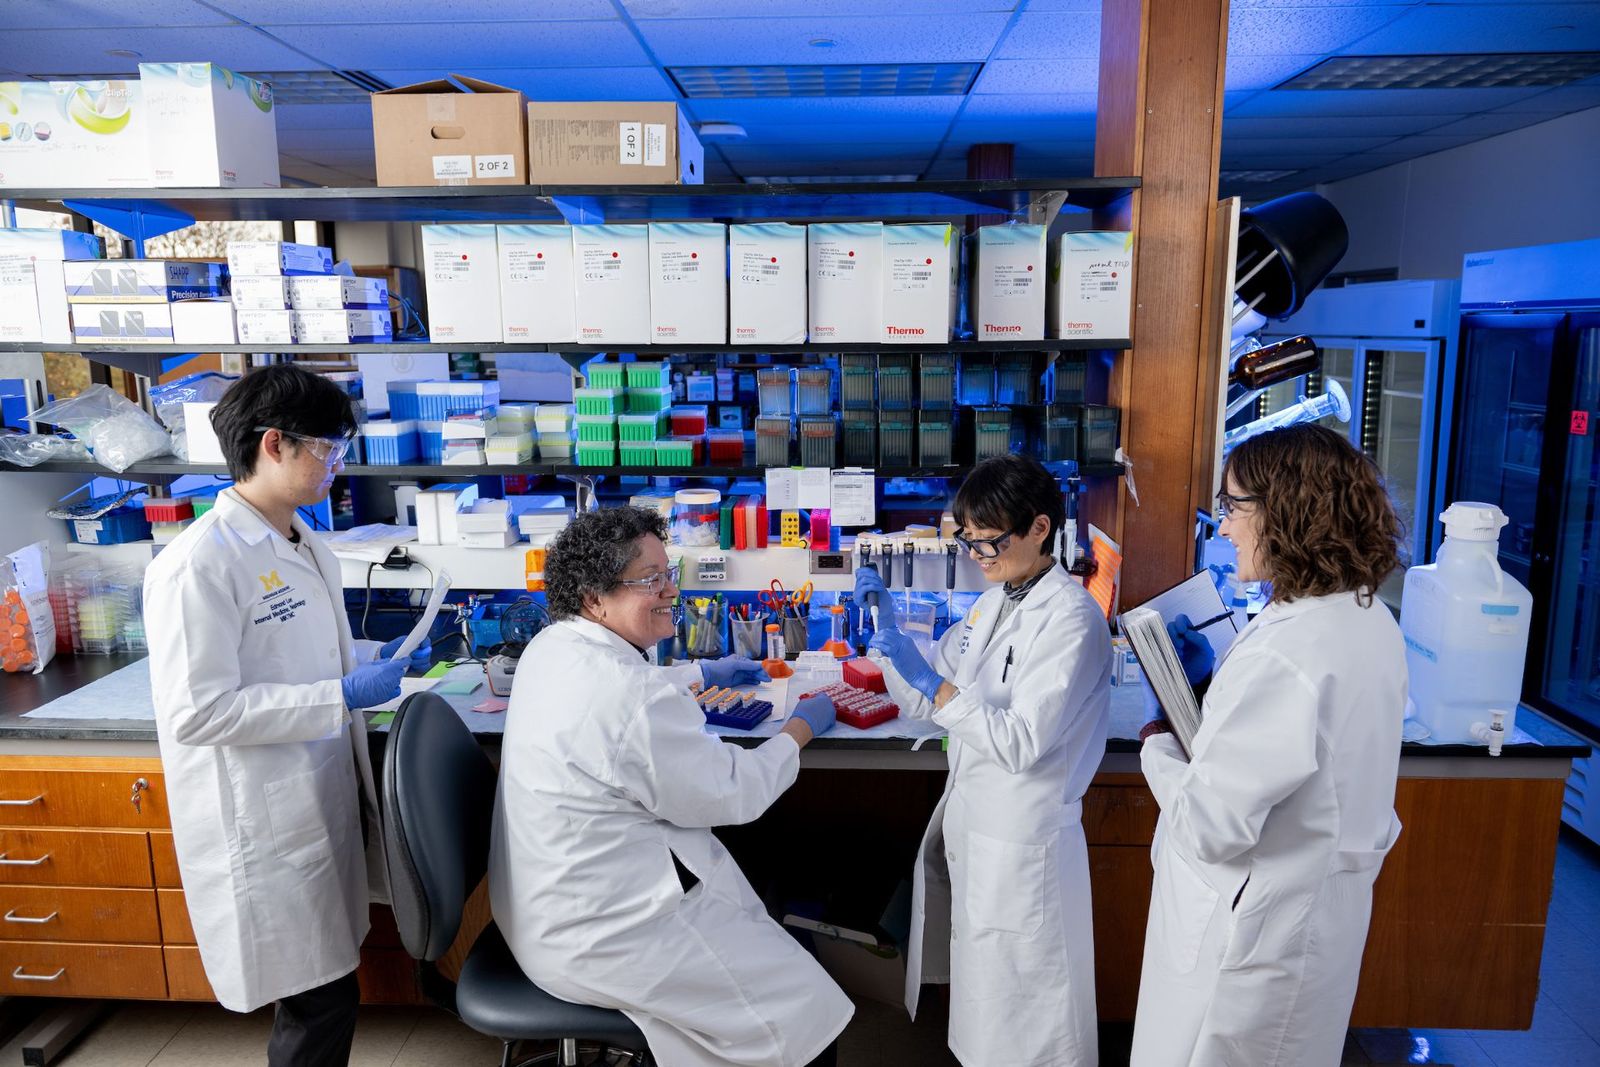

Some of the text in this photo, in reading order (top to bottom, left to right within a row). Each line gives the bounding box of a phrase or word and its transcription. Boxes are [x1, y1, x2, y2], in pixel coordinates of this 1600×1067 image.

[626, 134, 635, 149] OF
[479, 161, 508, 171] 2 OF 2
[171, 290, 198, 300] Precision
[984, 324, 1021, 332] Thermo
[1067, 321, 1092, 329] thermo
[887, 326, 924, 335] Thermo
[259, 570, 284, 591] M
